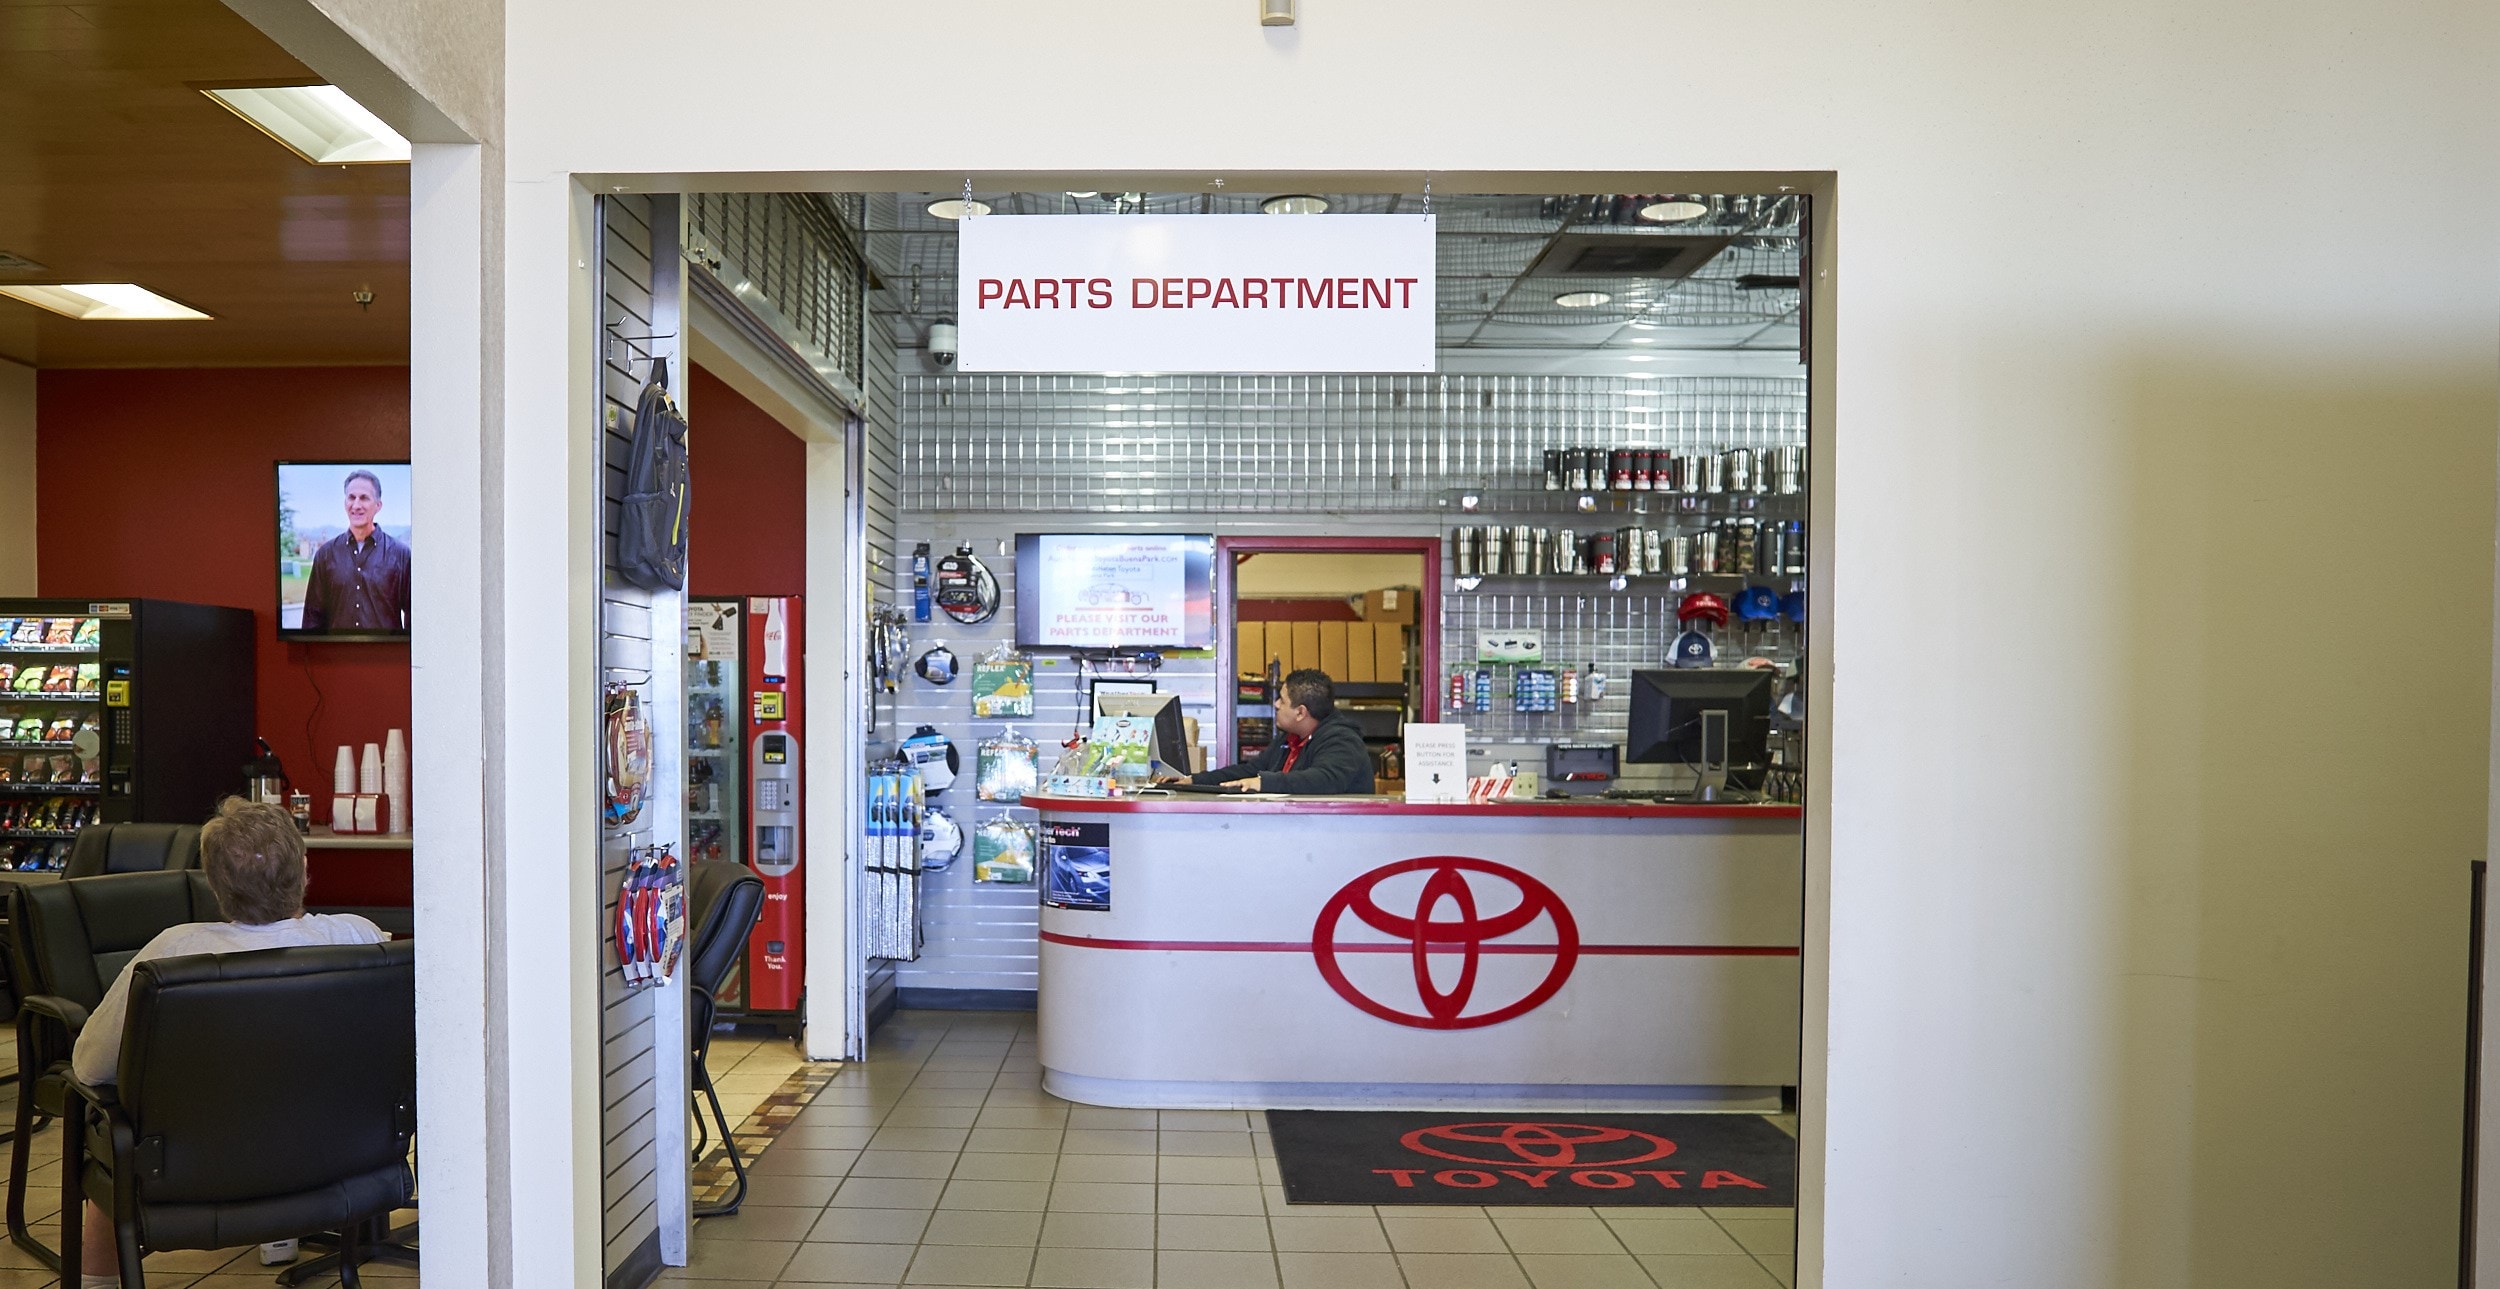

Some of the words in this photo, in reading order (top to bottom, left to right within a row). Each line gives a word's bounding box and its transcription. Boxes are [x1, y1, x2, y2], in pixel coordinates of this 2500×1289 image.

[978, 278, 1112, 309] PARTS
[1132, 278, 1418, 309] DEPARTMENT
[1056, 614, 1101, 623] PLEASE
[1141, 614, 1168, 623] OUR
[1049, 627, 1089, 636] PARTS
[976, 664, 1005, 673] REFLEX
[767, 893, 788, 901] enjoy
[764, 955, 786, 963] Thank
[1372, 1168, 1767, 1189] TOYOTA
